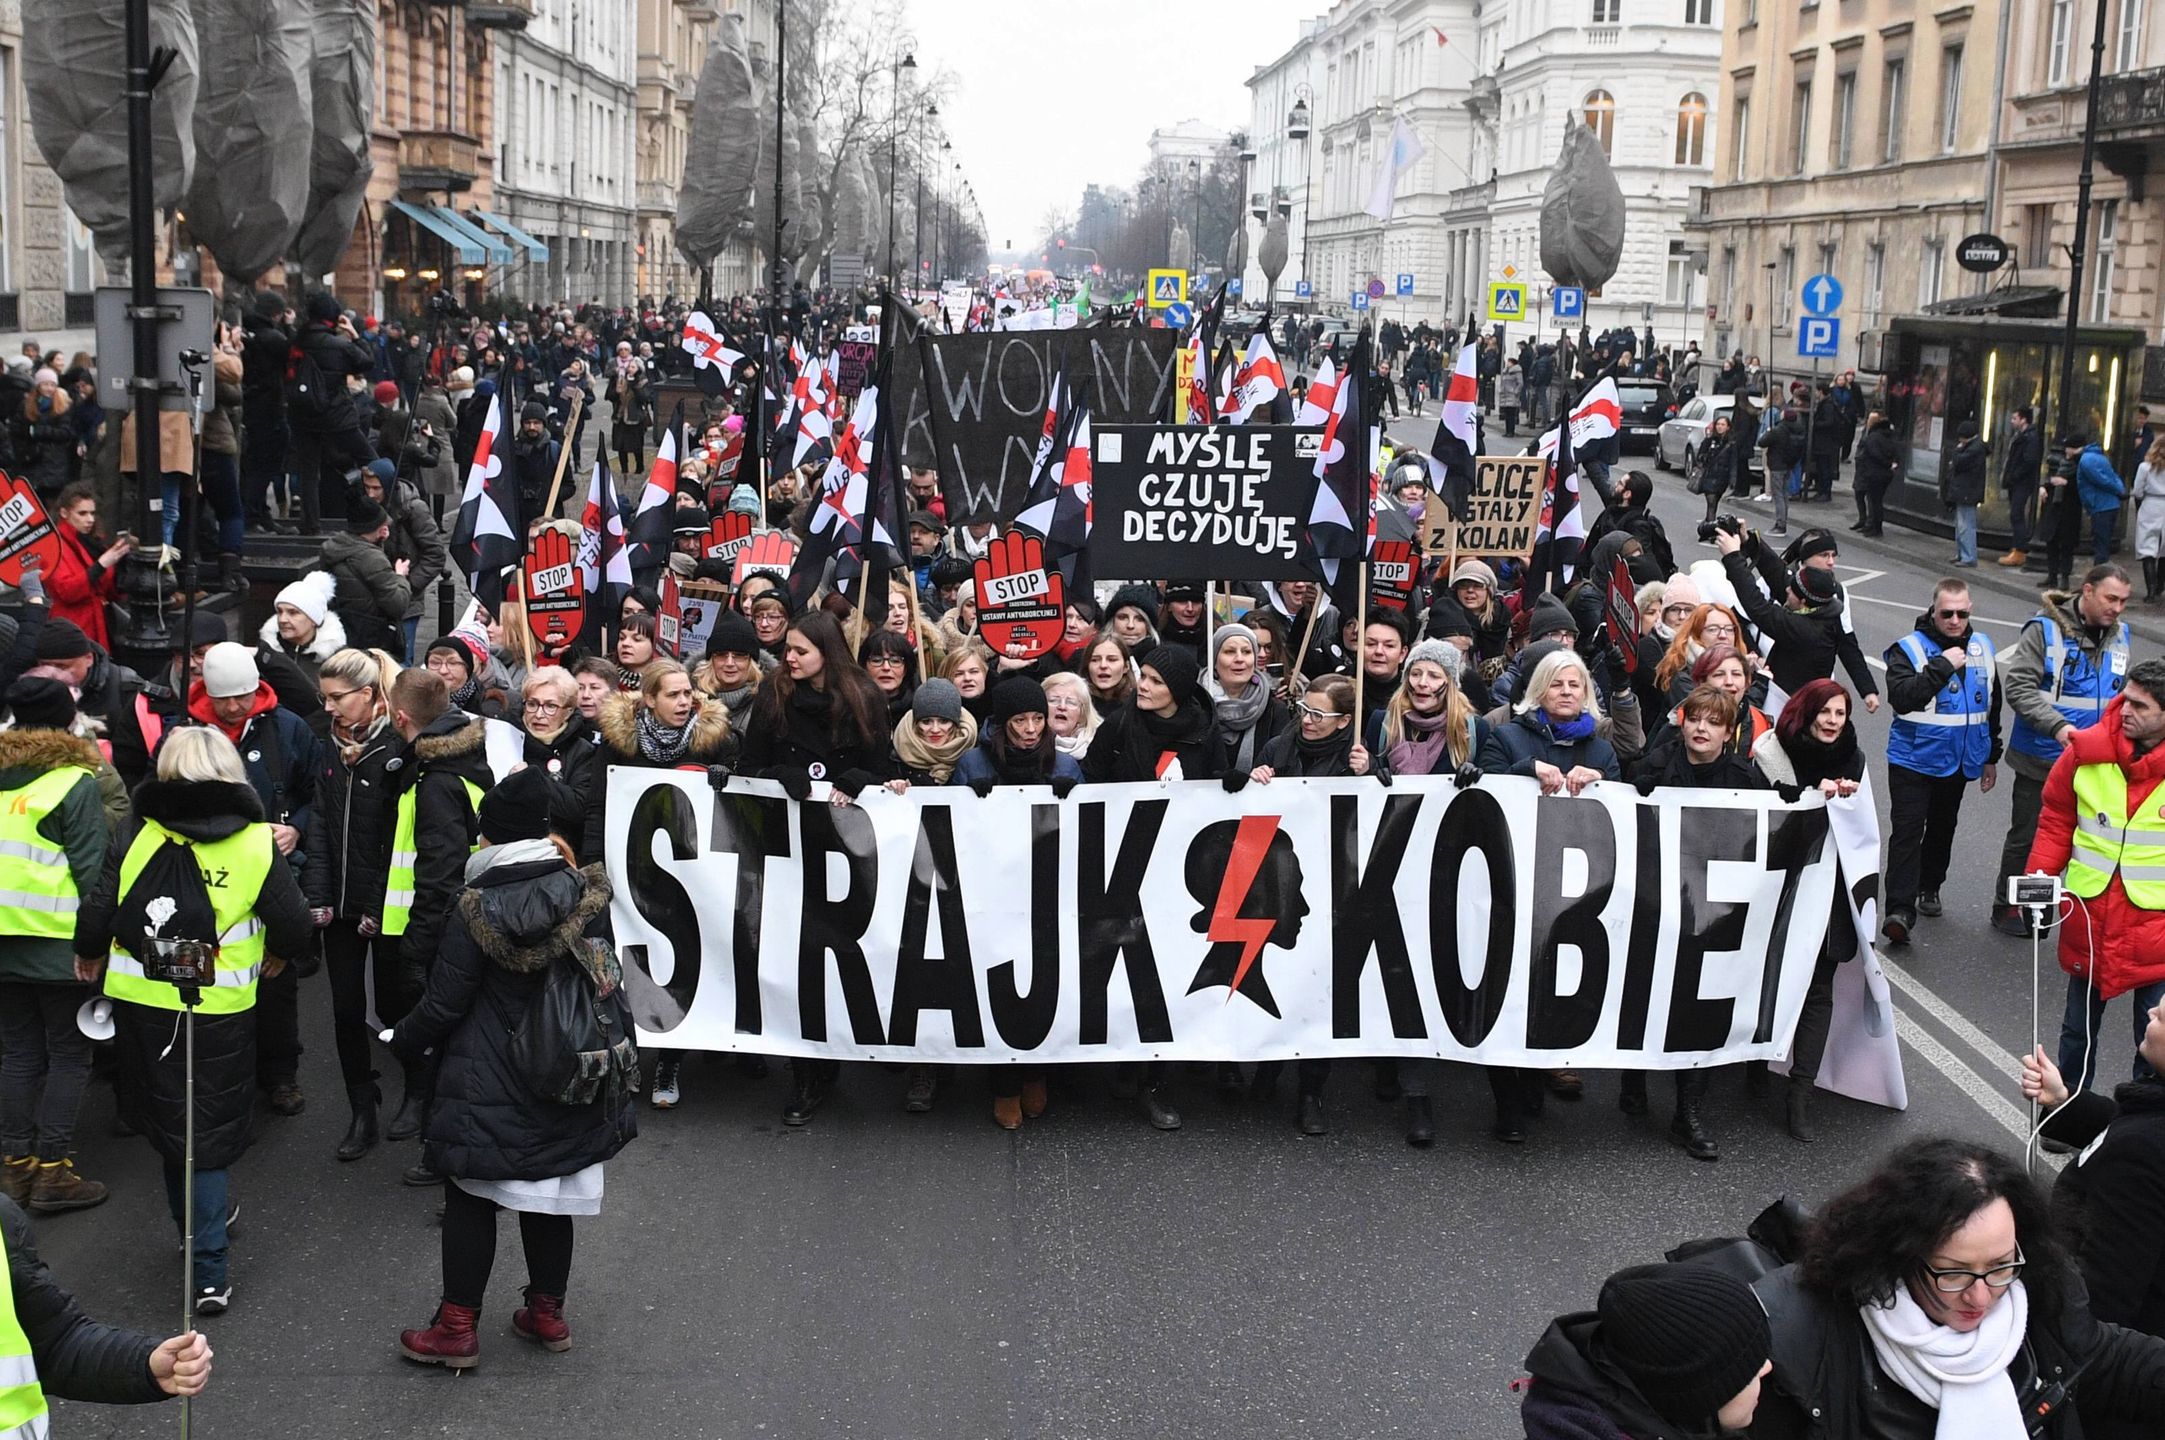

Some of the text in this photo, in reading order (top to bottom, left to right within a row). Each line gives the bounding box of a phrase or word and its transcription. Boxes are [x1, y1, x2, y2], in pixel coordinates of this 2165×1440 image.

[1232, 278, 1241, 289] P
[1299, 281, 1308, 294] P
[1401, 275, 1411, 289] P
[1355, 293, 1366, 308] P
[1560, 290, 1577, 313] P
[1806, 320, 1832, 353] P
[1146, 425, 1272, 481] MYŚLĘ
[1470, 462, 1539, 499] CICE
[1138, 473, 1264, 517] CZUJĘ
[1123, 510, 1297, 560] DECYDUJĘ
[1430, 526, 1529, 549] Z KOLAN
[538, 567, 568, 590] STOP
[994, 573, 1039, 599] STOP
[982, 608, 1058, 620] USTAWY ANTYABORCYJNEJ
[622, 782, 1827, 1053] STRAJK KOBIET
